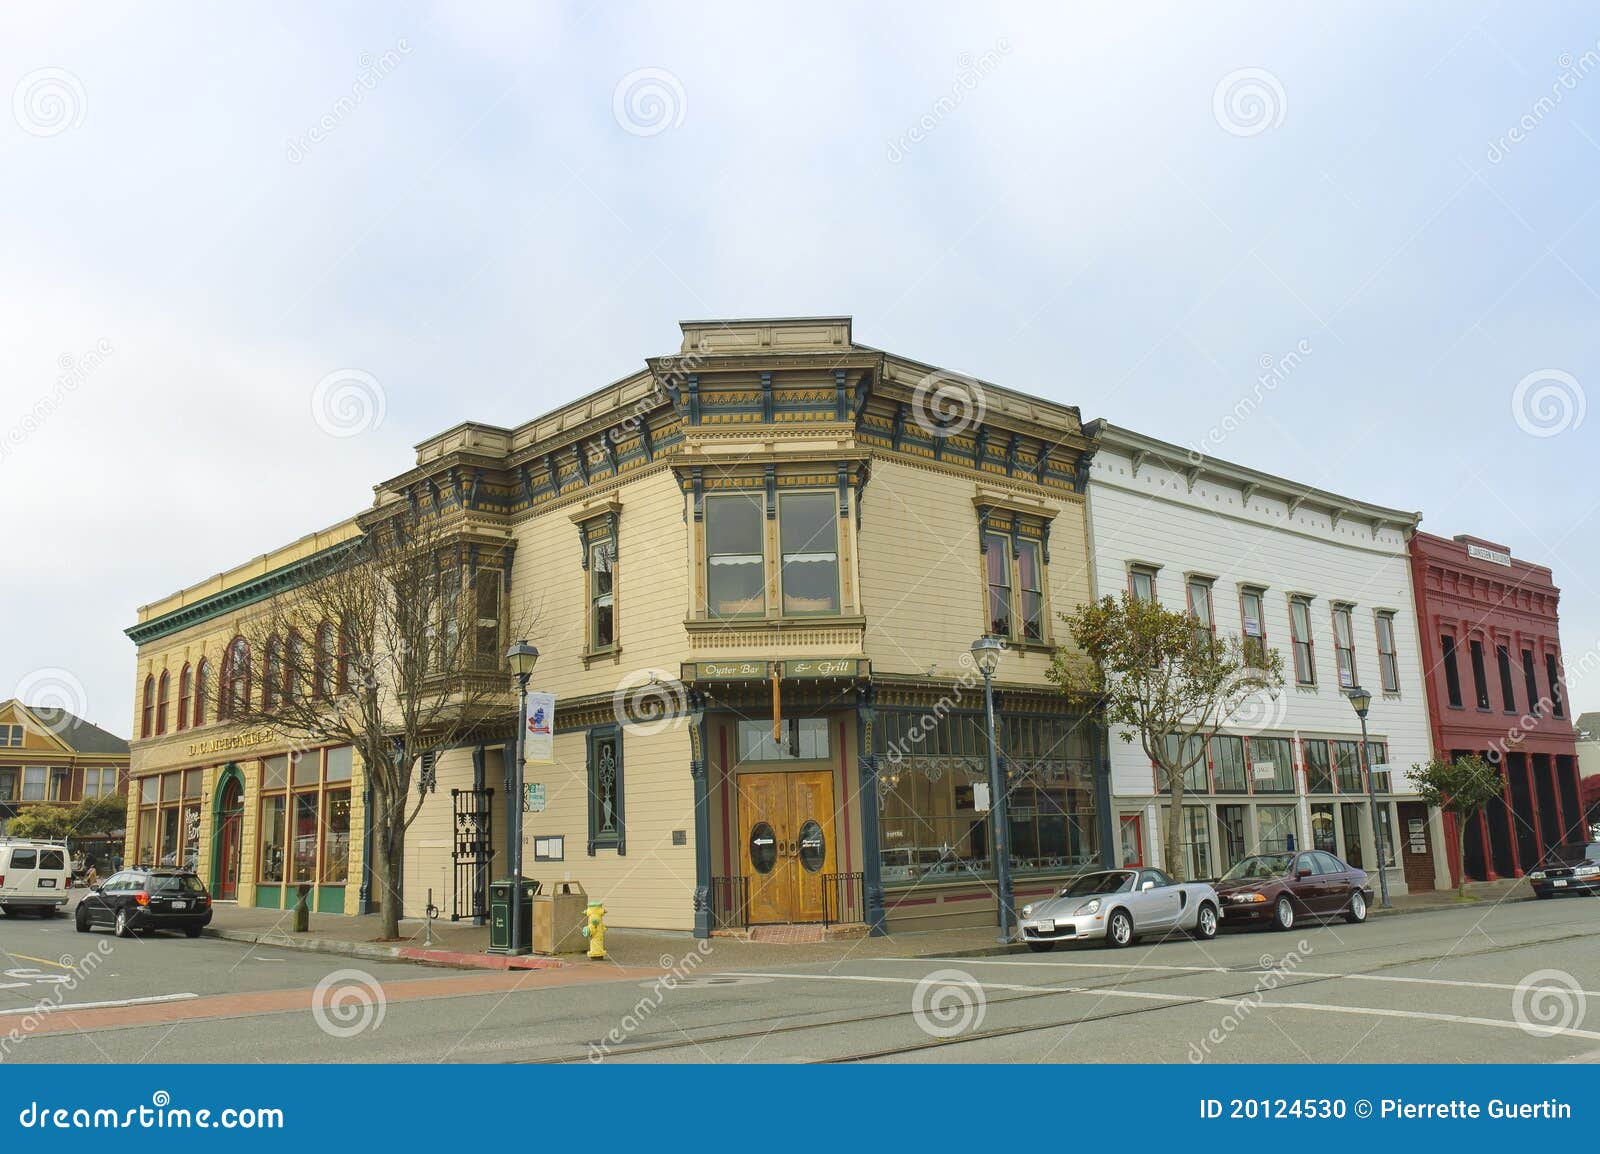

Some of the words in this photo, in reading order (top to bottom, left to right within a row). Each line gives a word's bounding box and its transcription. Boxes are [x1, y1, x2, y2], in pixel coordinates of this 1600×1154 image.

[705, 665, 737, 675] Oyster
[741, 664, 759, 674] Bar
[817, 661, 849, 676] Grill
